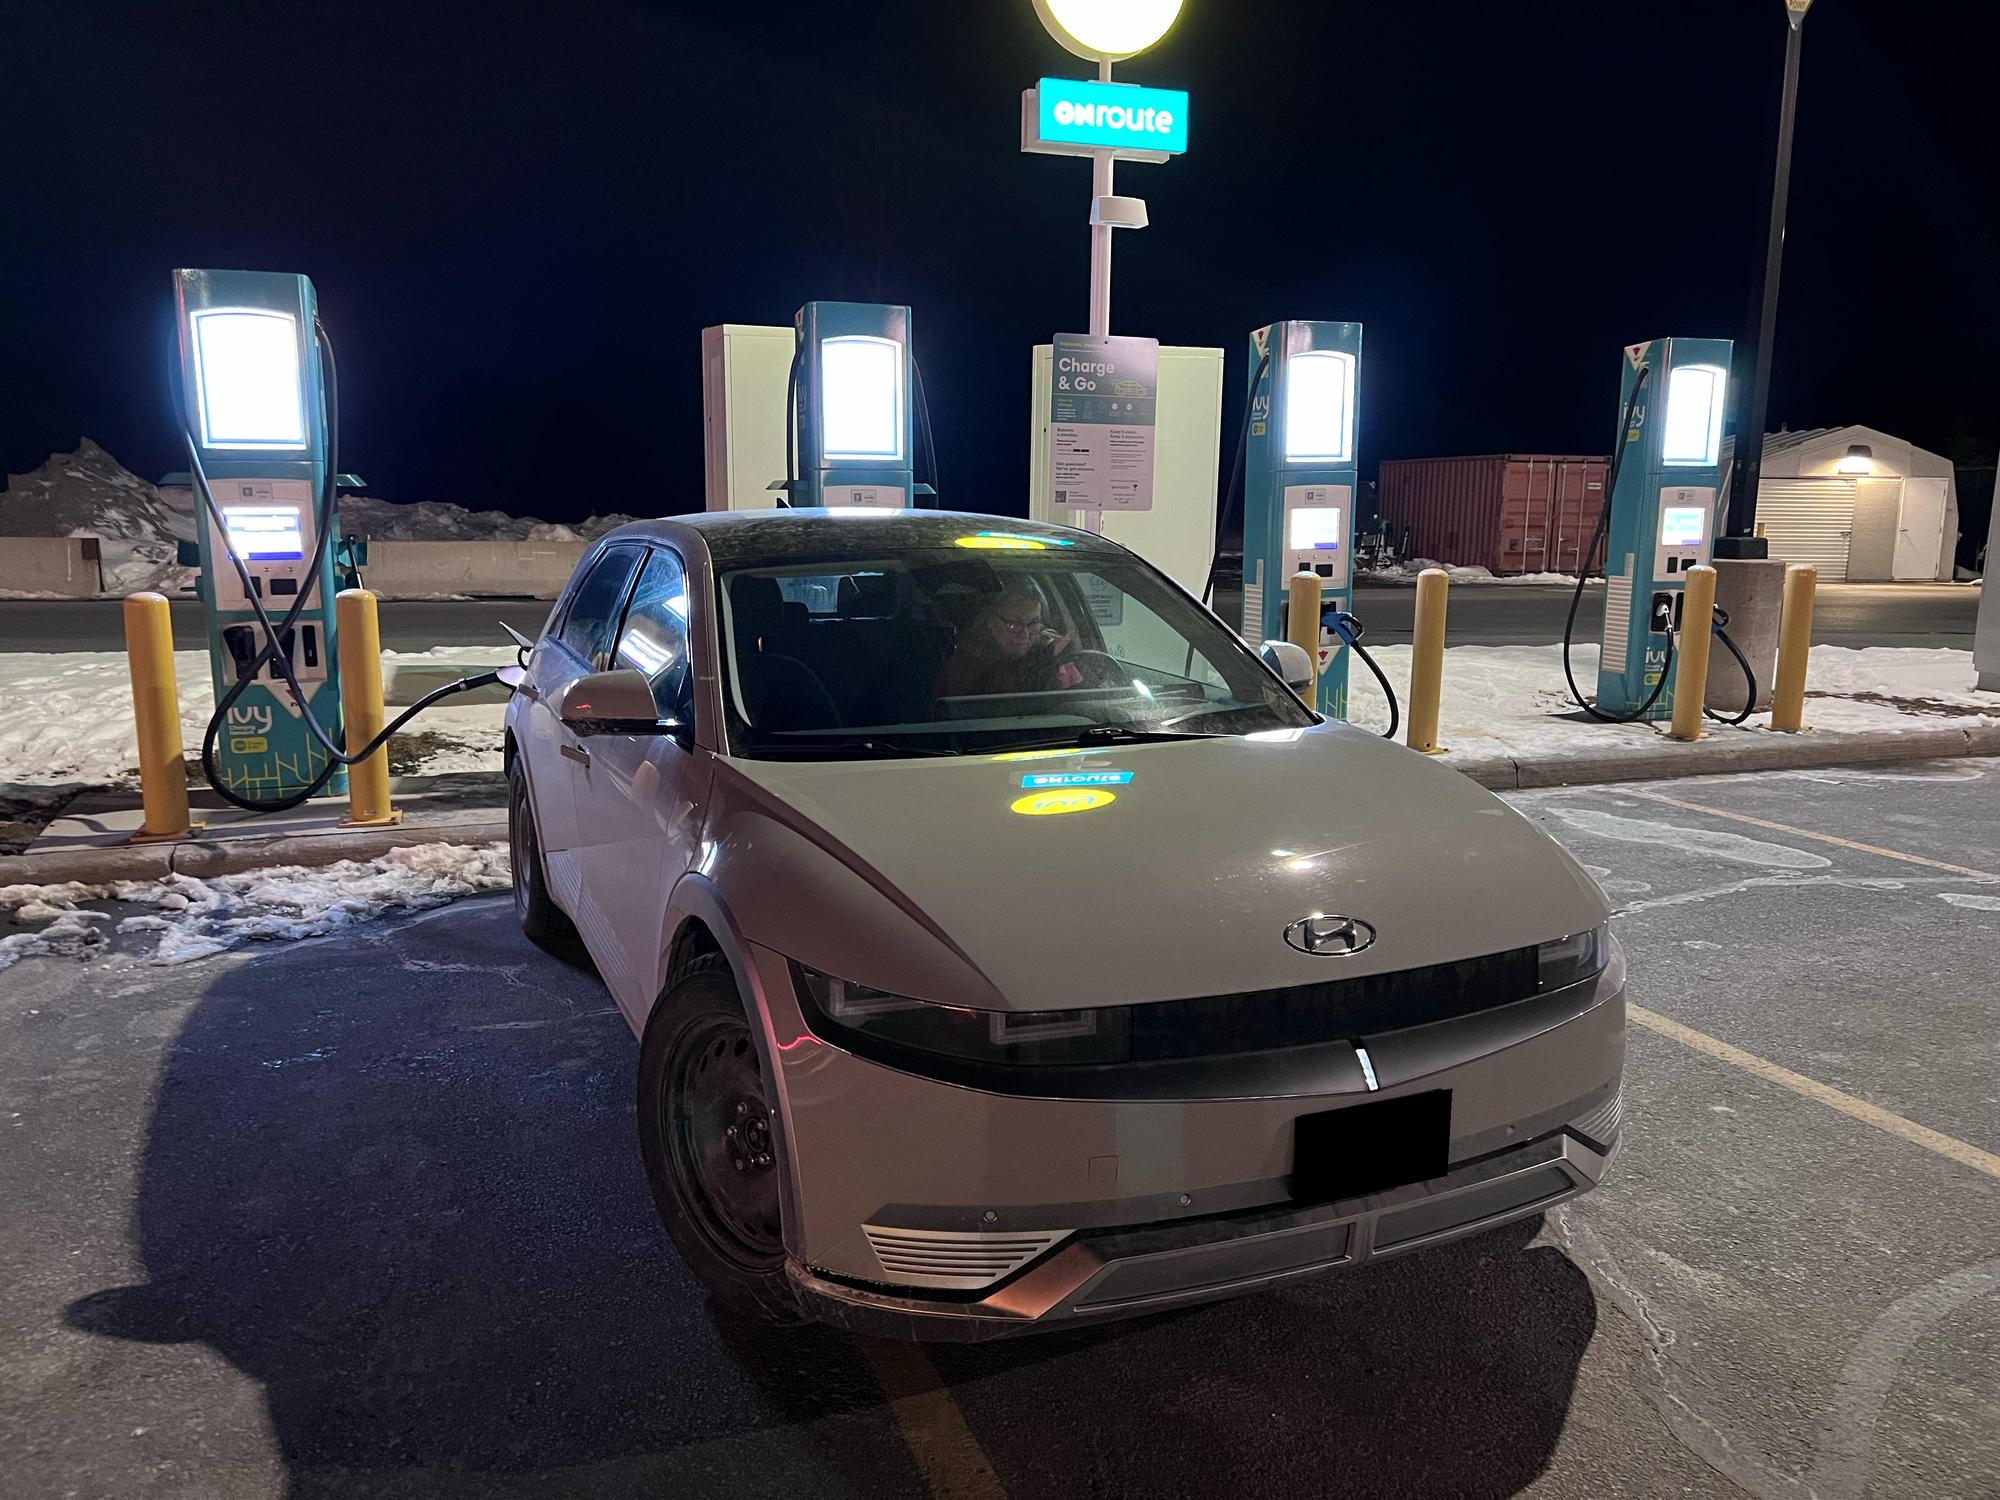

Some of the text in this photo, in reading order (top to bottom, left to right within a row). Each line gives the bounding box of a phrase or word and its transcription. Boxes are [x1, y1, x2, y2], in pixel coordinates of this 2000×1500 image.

[1058, 357, 1115, 376] Charge
[1058, 376, 1096, 391] & Go
